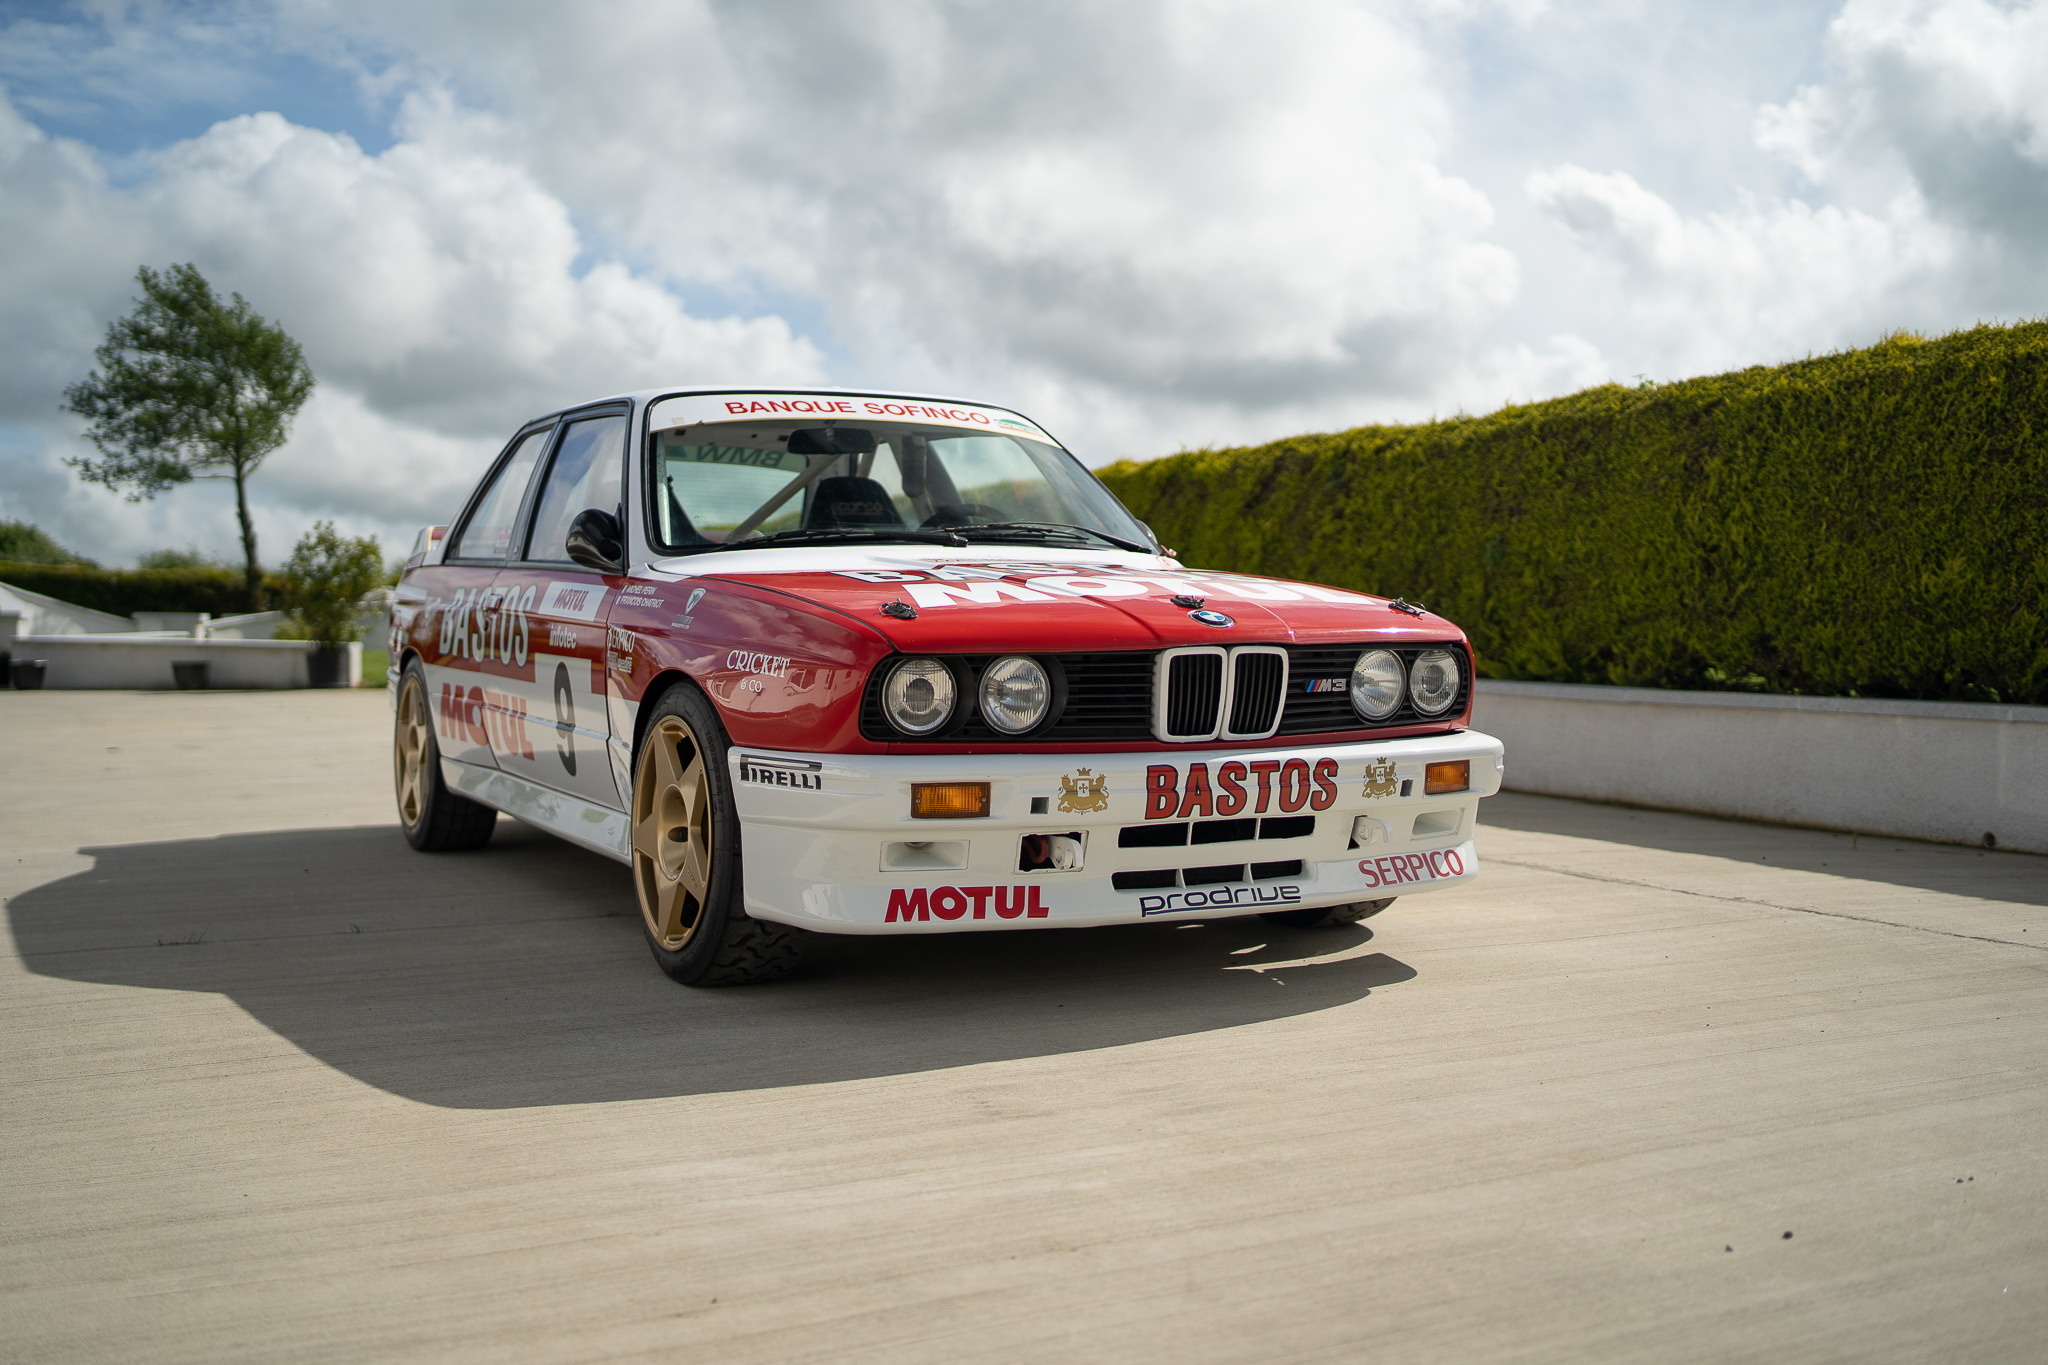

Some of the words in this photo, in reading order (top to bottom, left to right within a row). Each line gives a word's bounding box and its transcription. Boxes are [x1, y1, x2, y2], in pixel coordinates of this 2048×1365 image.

[724, 400, 857, 414] BANQUE
[863, 402, 990, 425] SOFINCO
[552, 588, 590, 612] MOTUL
[901, 575, 1377, 608] MOTUL
[438, 584, 538, 668] BASTOS
[549, 623, 577, 649] infotec
[726, 649, 791, 679] CRICKET
[740, 678, 747, 690] &
[749, 679, 762, 693] CO
[1314, 678, 1347, 693] M3
[440, 682, 535, 761] MOTUL
[554, 661, 577, 777] 9
[740, 753, 823, 791] PIRELLI
[1145, 757, 1339, 820] BASTOS
[1358, 849, 1464, 888] SERPICO
[884, 885, 1050, 923] MOTUL
[1139, 885, 1301, 917] prodrive
